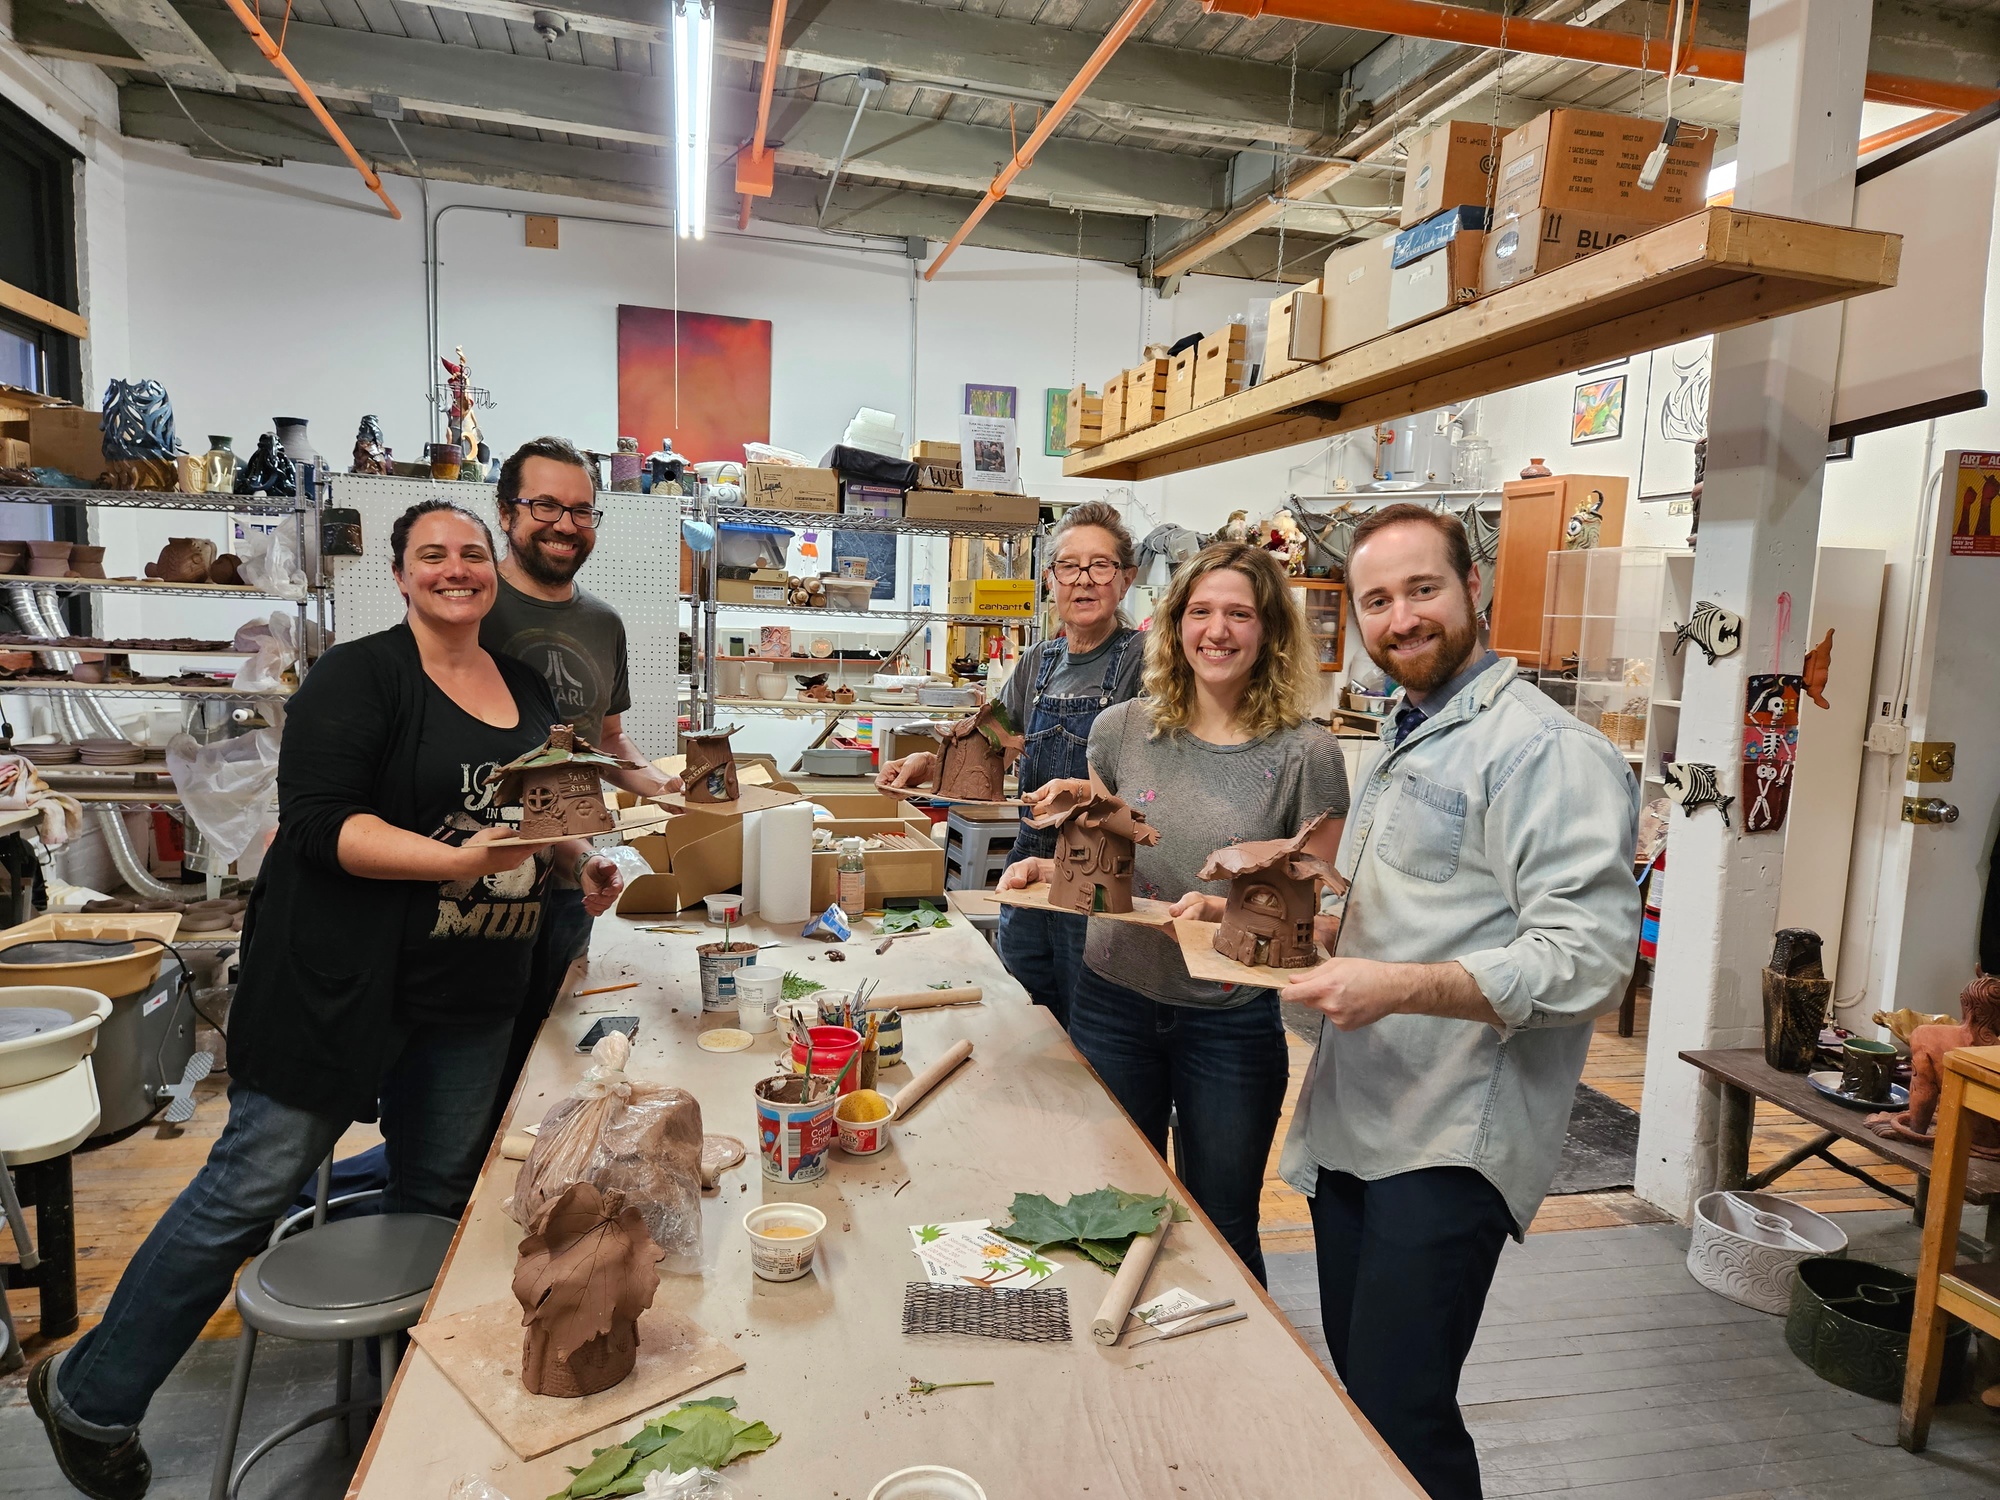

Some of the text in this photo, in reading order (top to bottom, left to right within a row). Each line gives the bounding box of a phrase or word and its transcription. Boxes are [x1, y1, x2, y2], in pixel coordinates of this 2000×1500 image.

[1469, 139, 1487, 147] WHITE
[1961, 454, 1982, 464] ART
[979, 603, 1022, 611] carhartt
[1882, 703, 1890, 716] 4
[485, 808, 499, 819] IN
[428, 899, 541, 939] MUD
